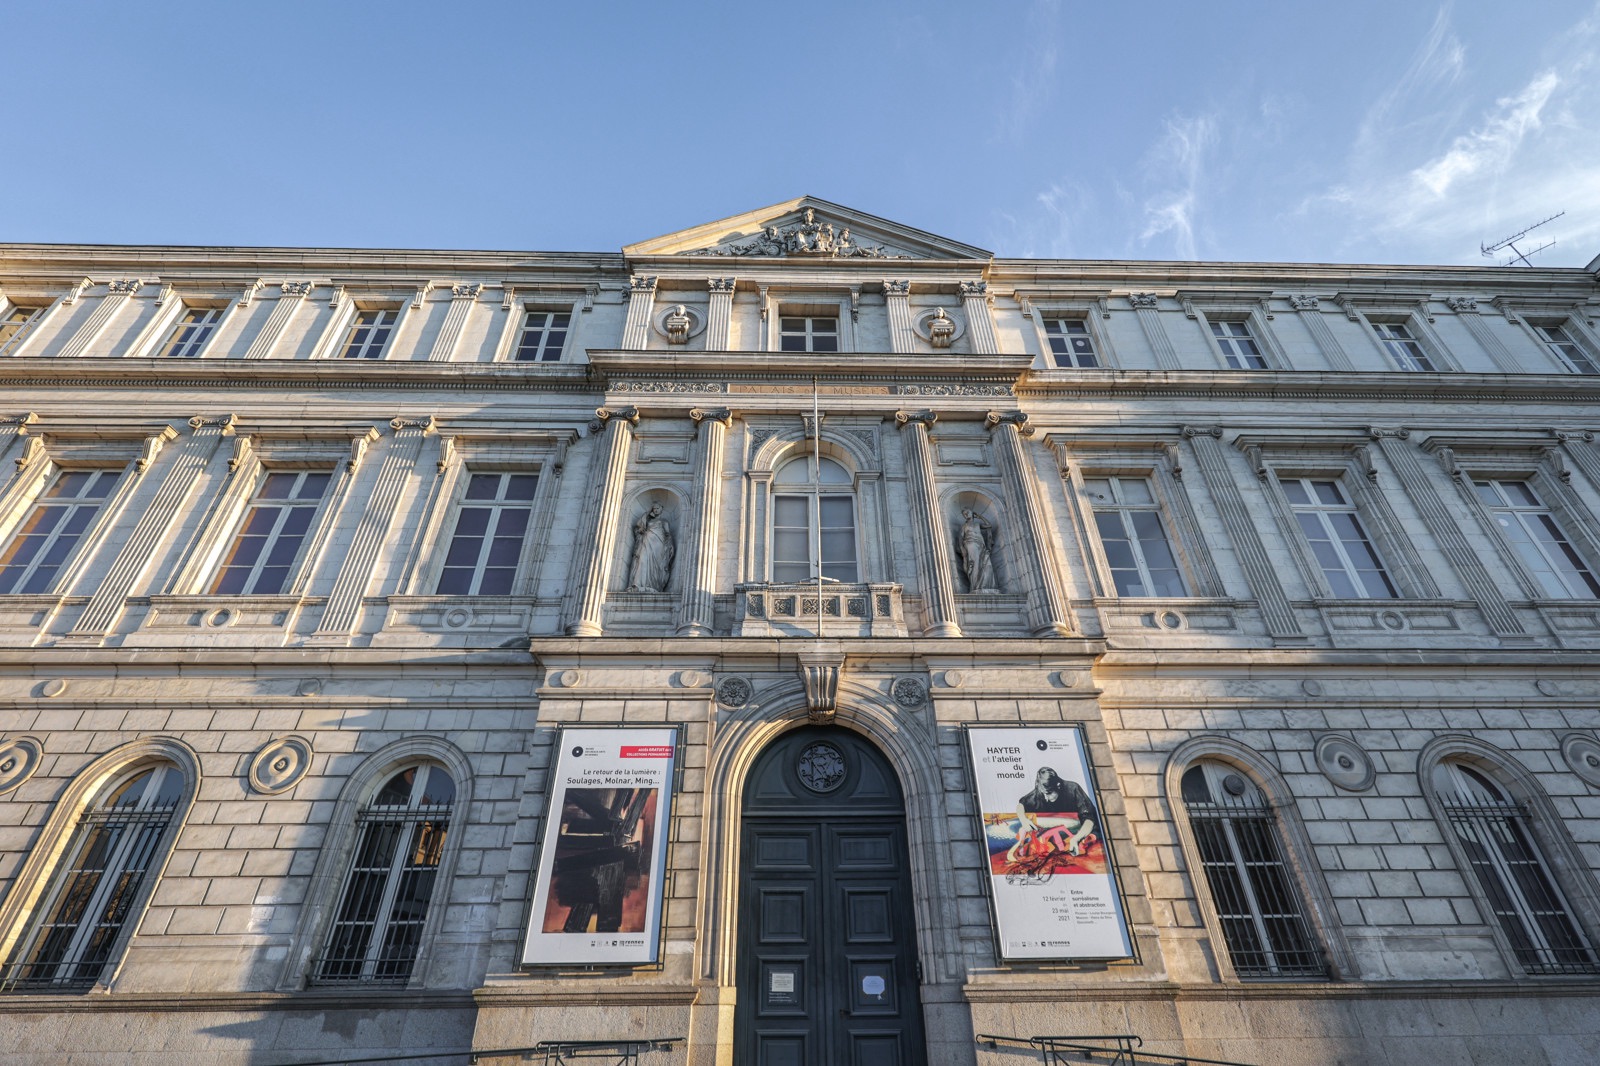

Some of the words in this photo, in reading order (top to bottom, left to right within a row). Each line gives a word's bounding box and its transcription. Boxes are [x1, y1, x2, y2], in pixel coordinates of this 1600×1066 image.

[740, 386, 795, 394] PALAIS
[992, 755, 1022, 763] l'atelier
[1013, 763, 1024, 771] du
[996, 771, 1025, 779] monde
[567, 777, 603, 785] Soulages,
[604, 777, 633, 785] Molnar,
